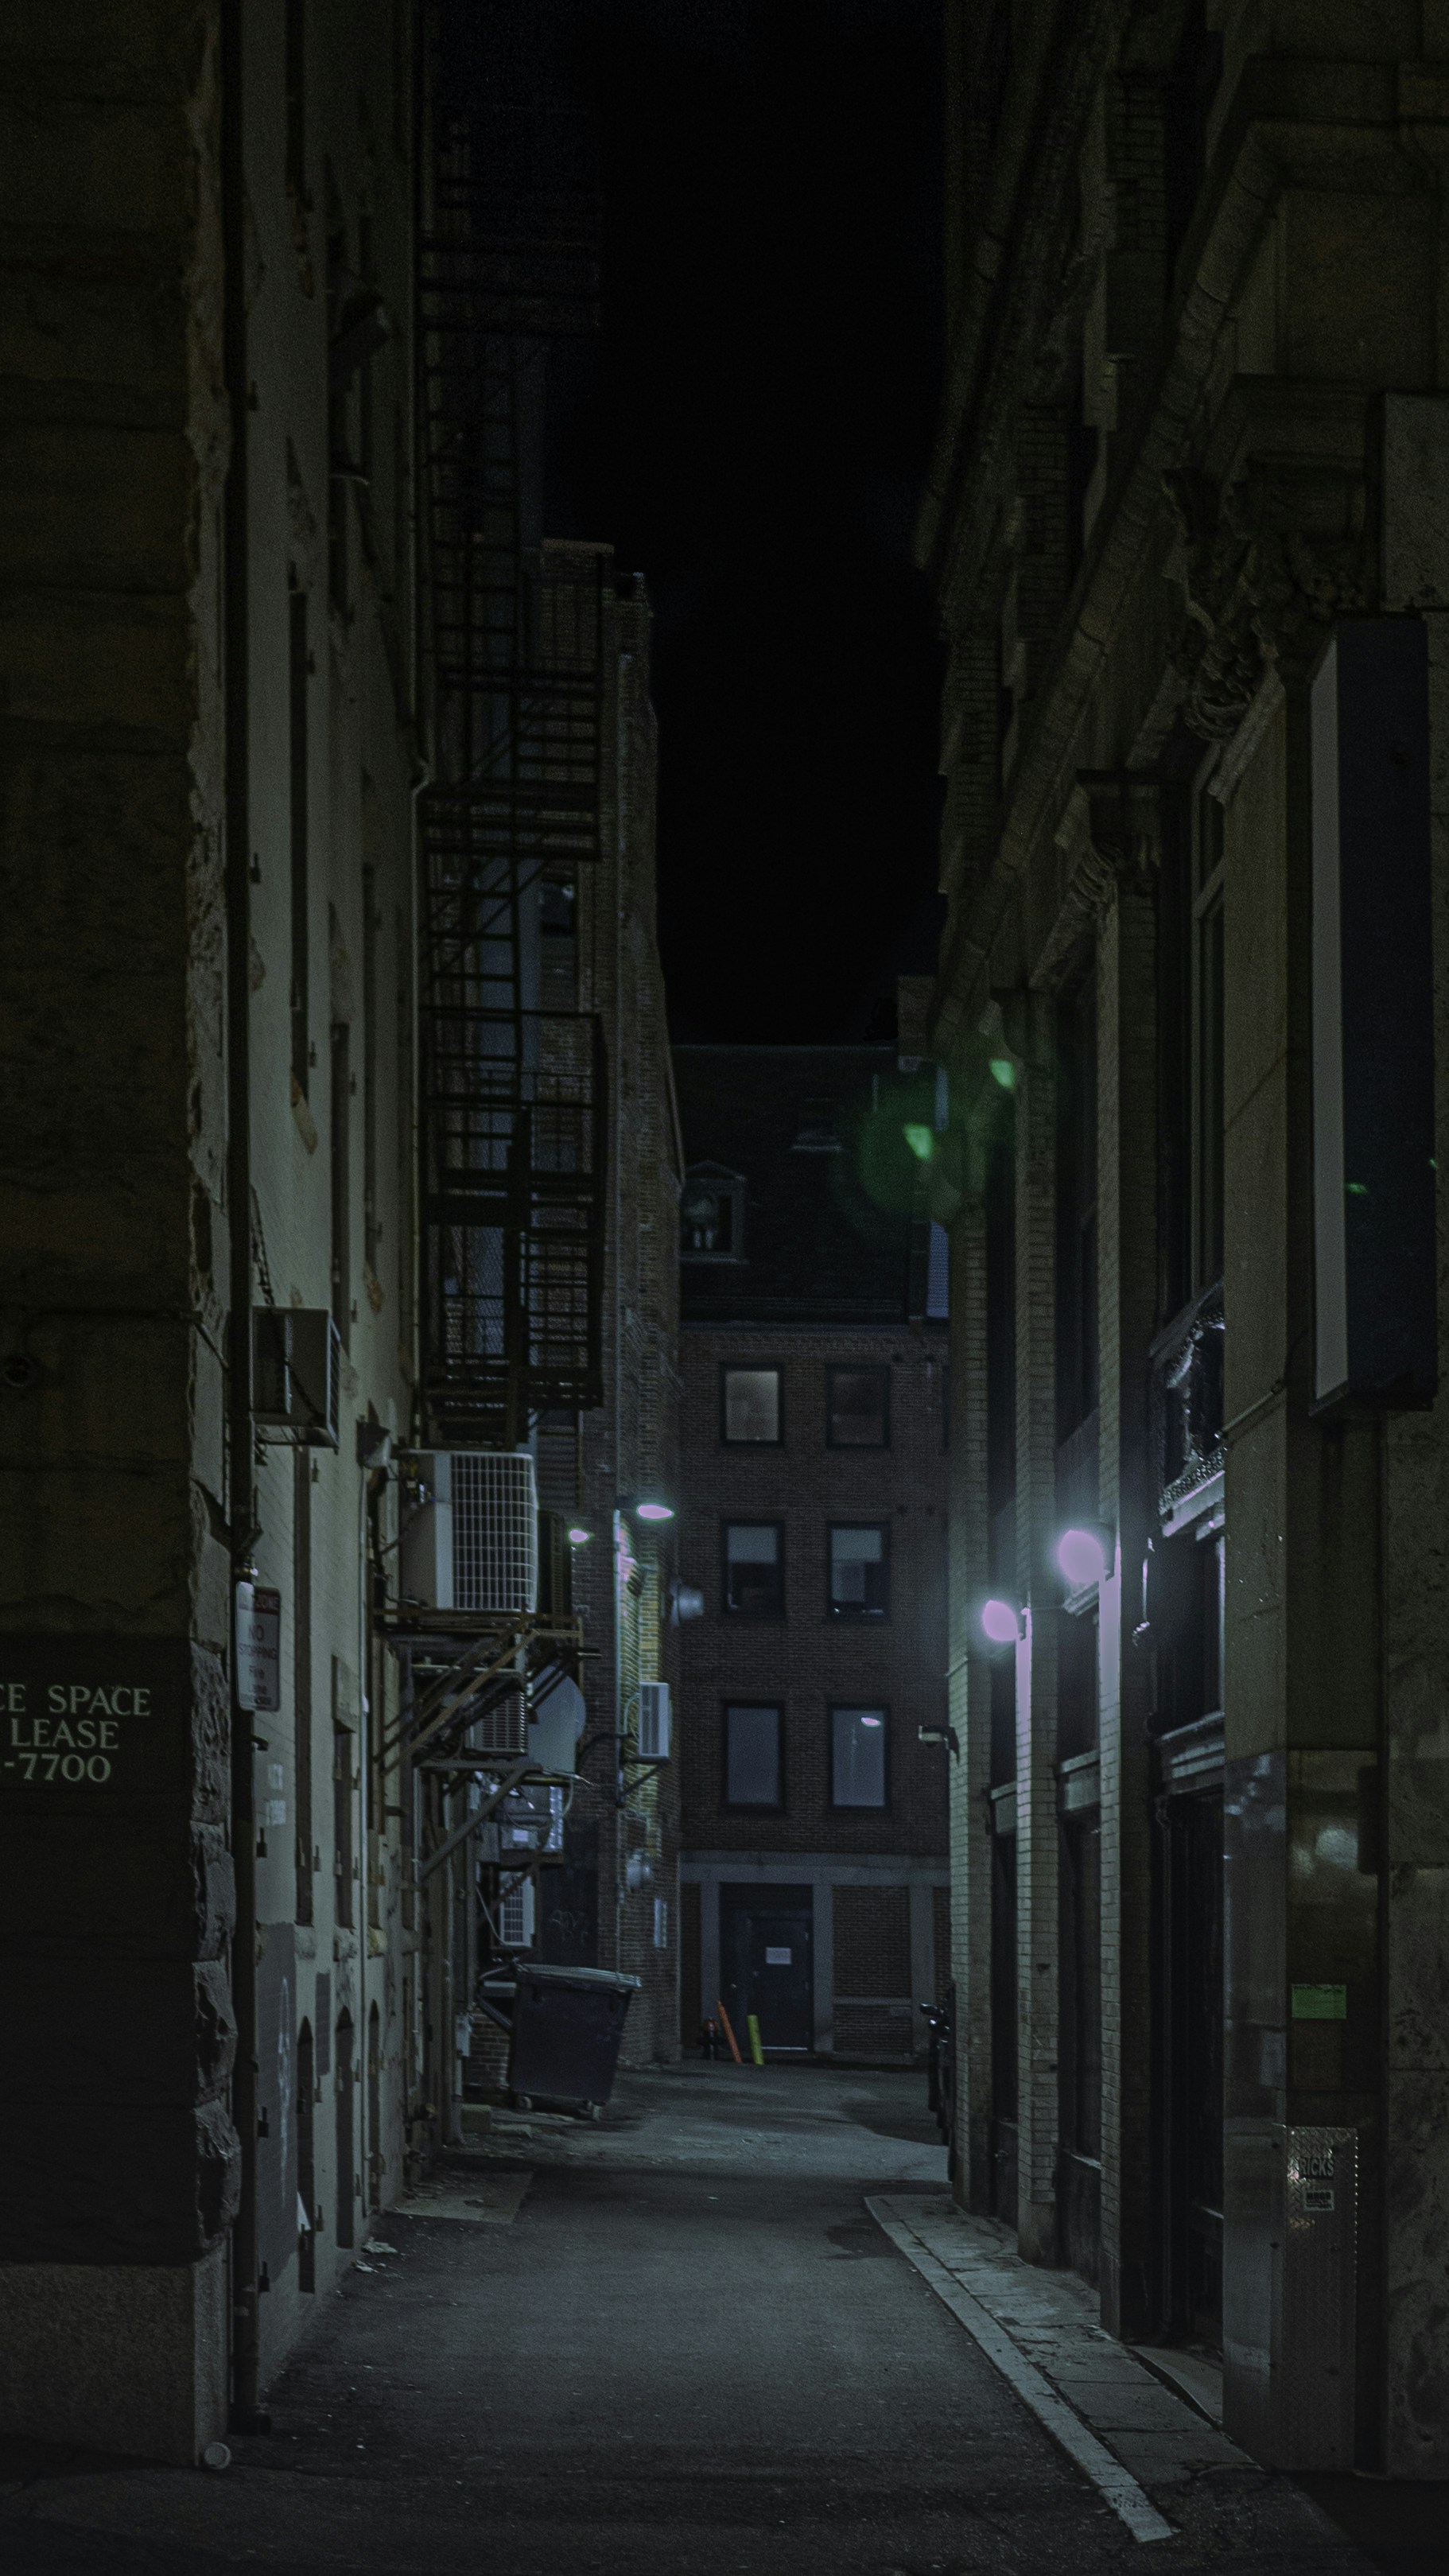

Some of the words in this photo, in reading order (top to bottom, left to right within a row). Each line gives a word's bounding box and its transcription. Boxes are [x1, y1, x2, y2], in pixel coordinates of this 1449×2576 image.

[248, 1625, 264, 1642] NO
[48, 1684, 151, 1716] SPACE
[11, 1718, 119, 1749] LEASE
[4, 1753, 111, 1782] -7700
